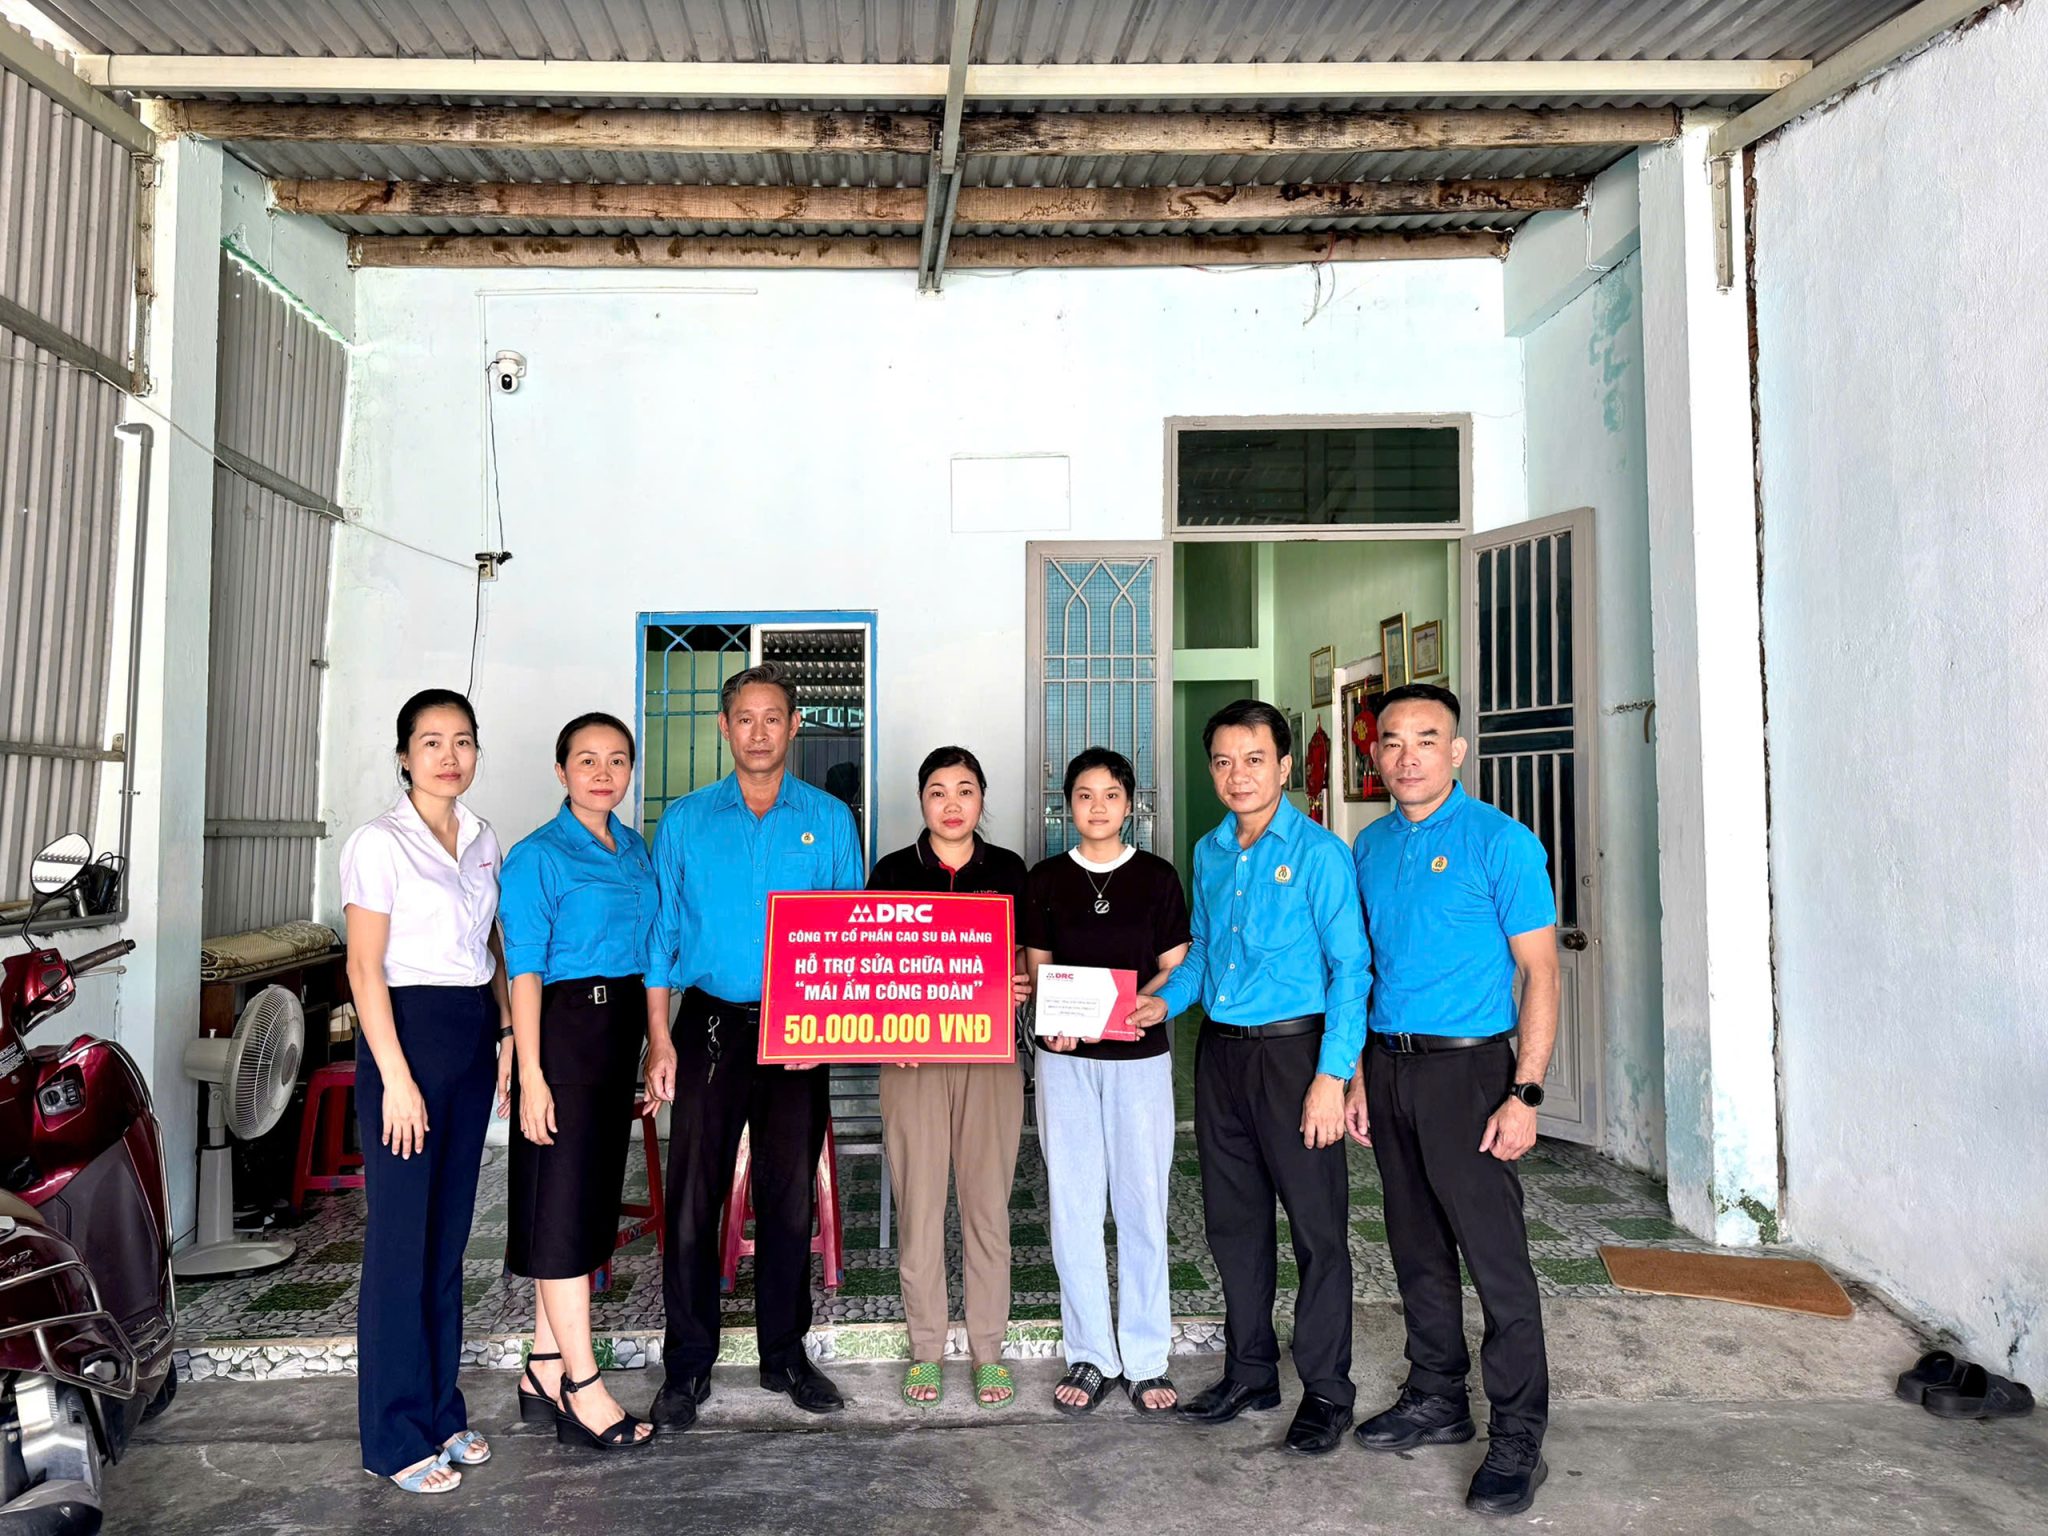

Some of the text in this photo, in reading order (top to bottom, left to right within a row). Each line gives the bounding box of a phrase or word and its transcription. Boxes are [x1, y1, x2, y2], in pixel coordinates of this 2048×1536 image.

[876, 903, 933, 923] DRC
[788, 929, 821, 943] CÔNG
[824, 931, 838, 942] TY
[896, 931, 919, 942] CAO
[922, 931, 938, 942] SU
[941, 929, 957, 942] ĐÀ
[795, 952, 984, 977] HỖ TRỢ SỬA CHỮA NHÀ
[843, 979, 870, 1000] ẤM
[875, 981, 922, 1000] CÔNG
[784, 1013, 992, 1044] 50.000.000 VNĐ
